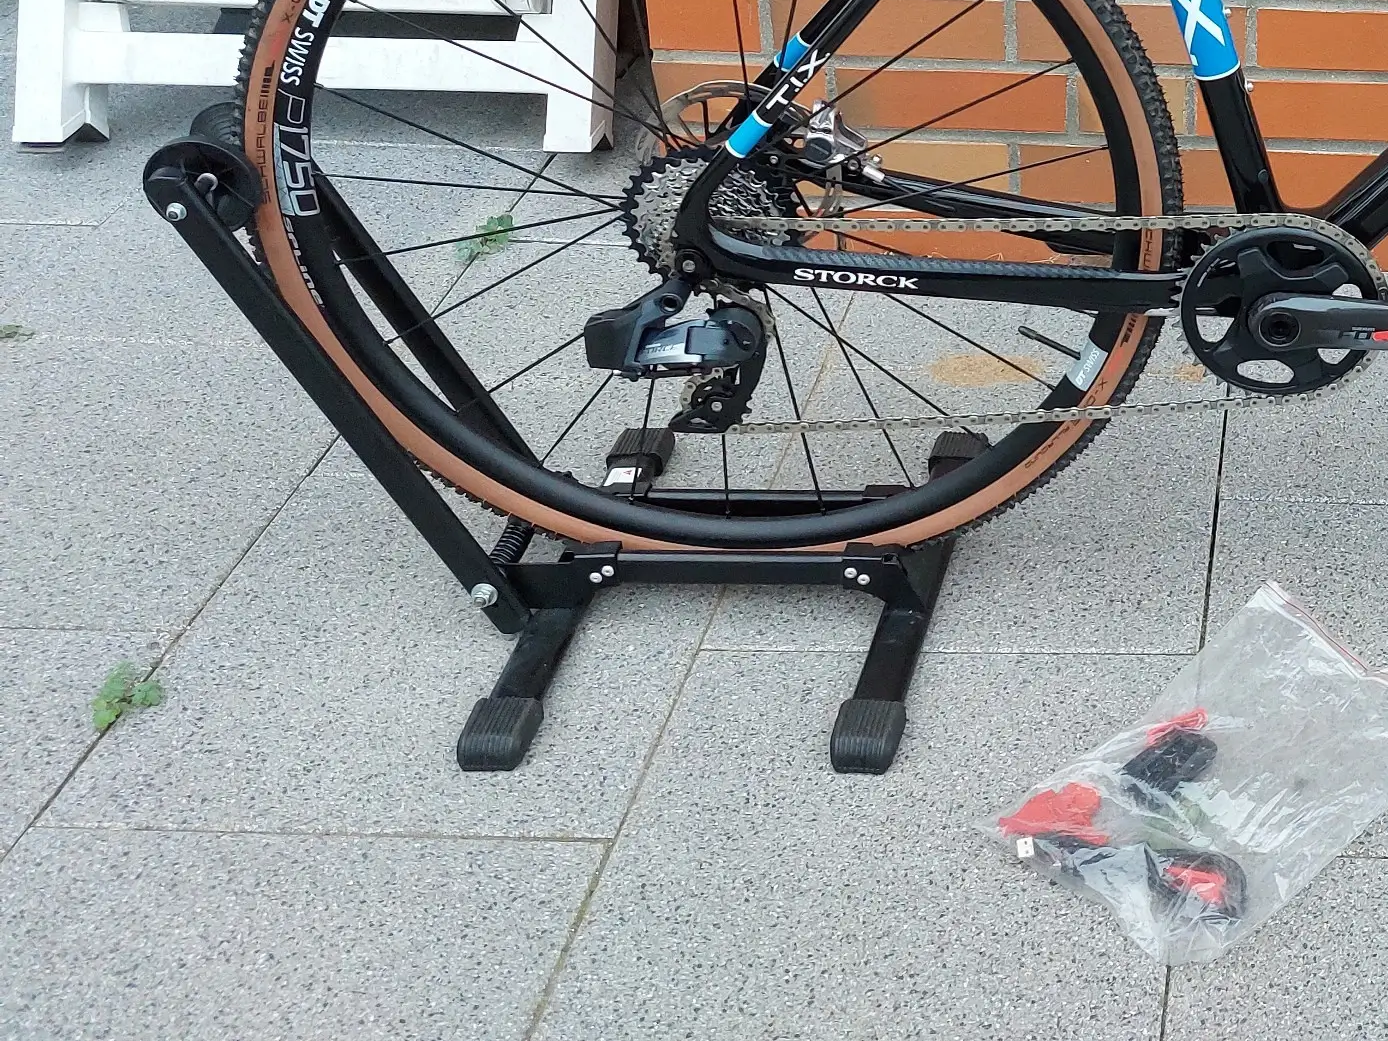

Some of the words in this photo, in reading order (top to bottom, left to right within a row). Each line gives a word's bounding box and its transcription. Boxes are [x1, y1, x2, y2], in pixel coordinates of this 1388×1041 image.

[280, 26, 315, 87] SWISS
[793, 267, 919, 290] STORCK
[1075, 370, 1088, 386] DT
[1084, 347, 1101, 373] SWISS
